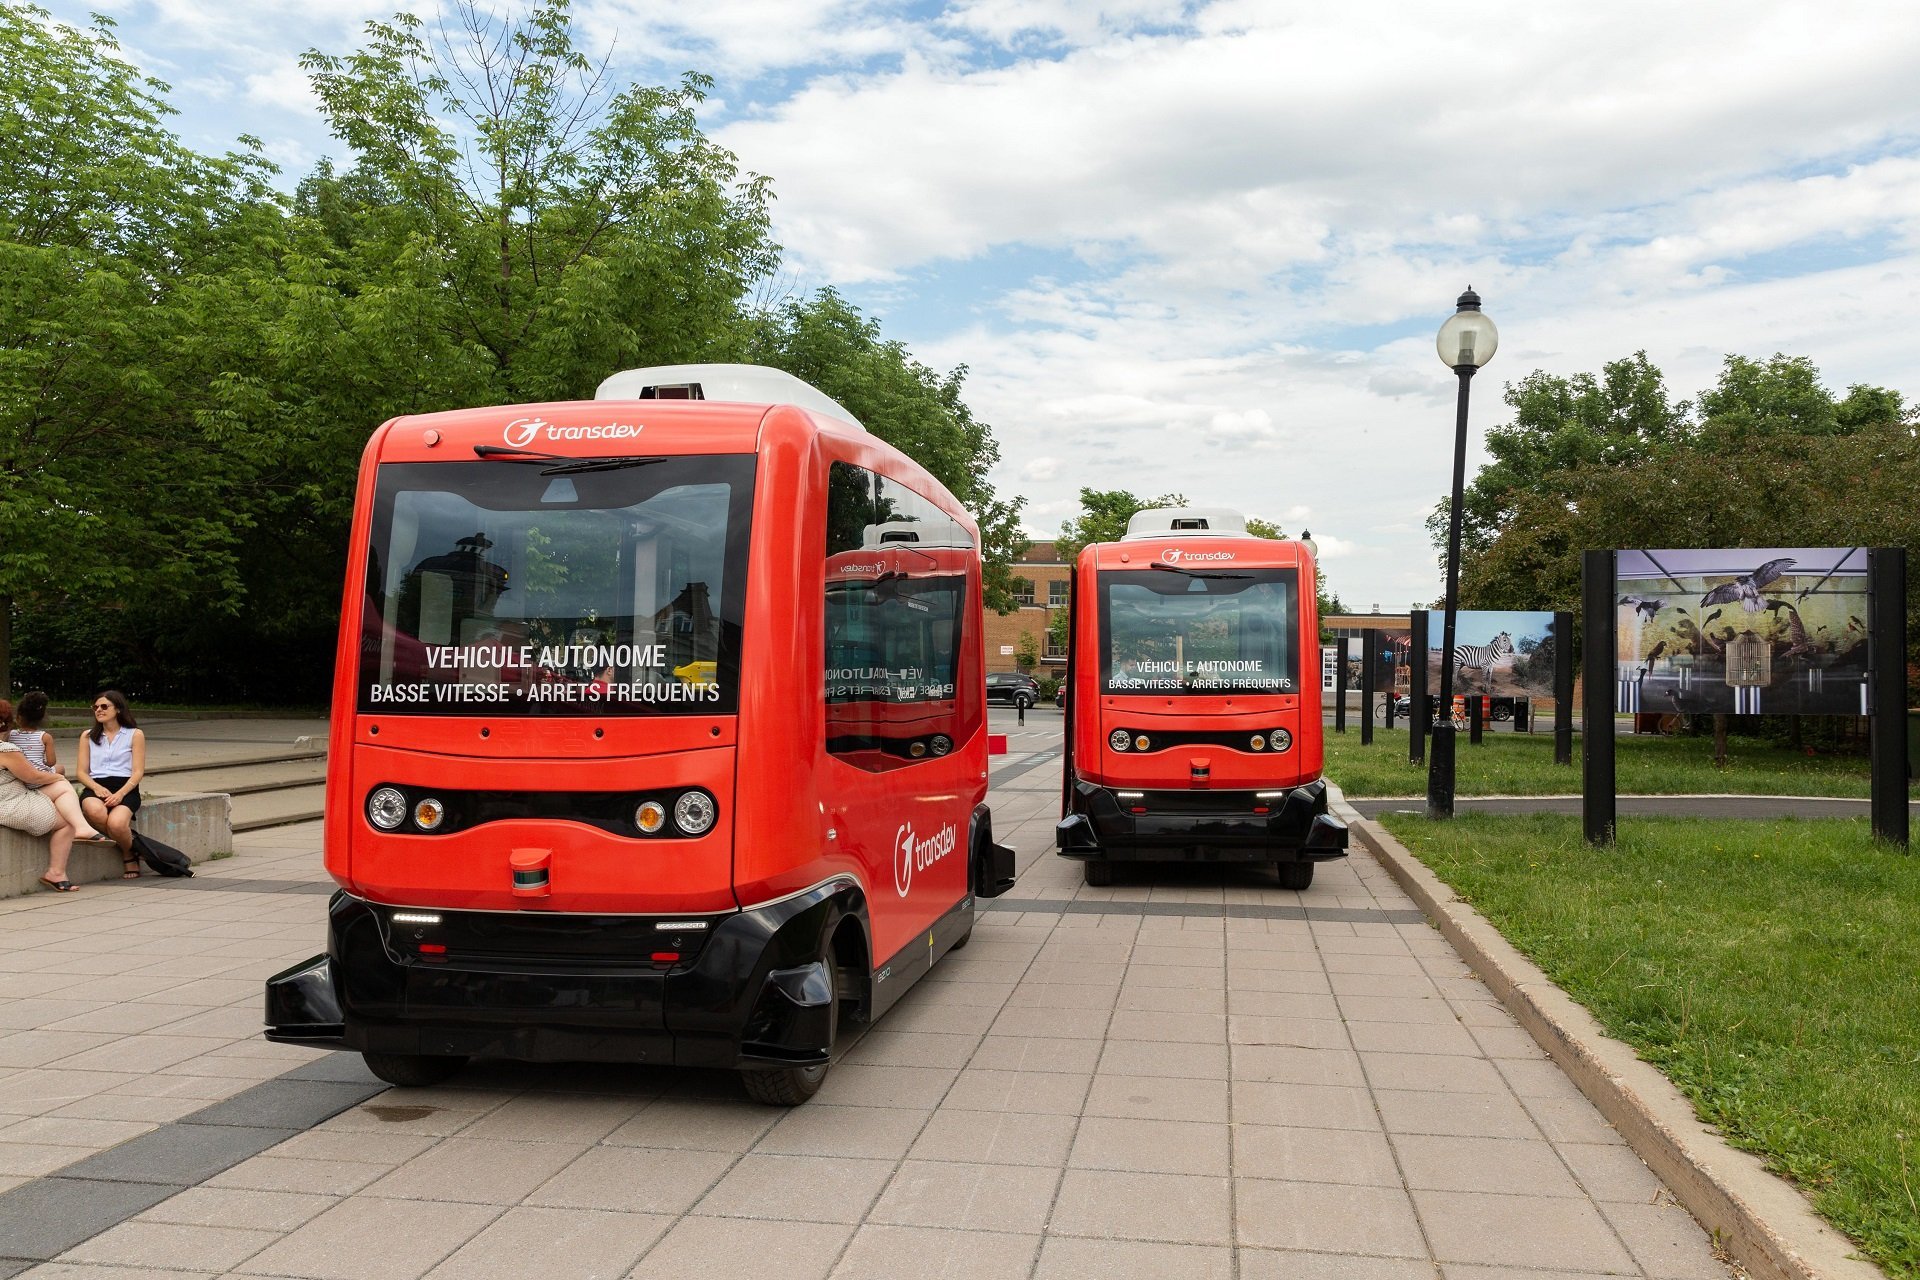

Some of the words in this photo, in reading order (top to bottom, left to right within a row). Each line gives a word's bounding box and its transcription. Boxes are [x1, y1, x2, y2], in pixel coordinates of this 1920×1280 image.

[547, 422, 644, 440] transdev
[1184, 552, 1235, 561] transdev
[425, 645, 533, 669] VEHICULE
[538, 645, 666, 668] AUTONOME
[1136, 658, 1194, 673] VÉHICUE
[1196, 660, 1263, 672] AUTONOME
[371, 683, 430, 702] BASSE
[435, 683, 510, 702] VITESSE
[526, 683, 600, 702] ARRETS
[606, 679, 720, 704] FRÉQUENTS
[1108, 679, 1140, 689] BASSE
[1143, 679, 1183, 689] VITESSE
[1232, 677, 1291, 690] FRÉQUENTS
[916, 822, 956, 871] transdev
